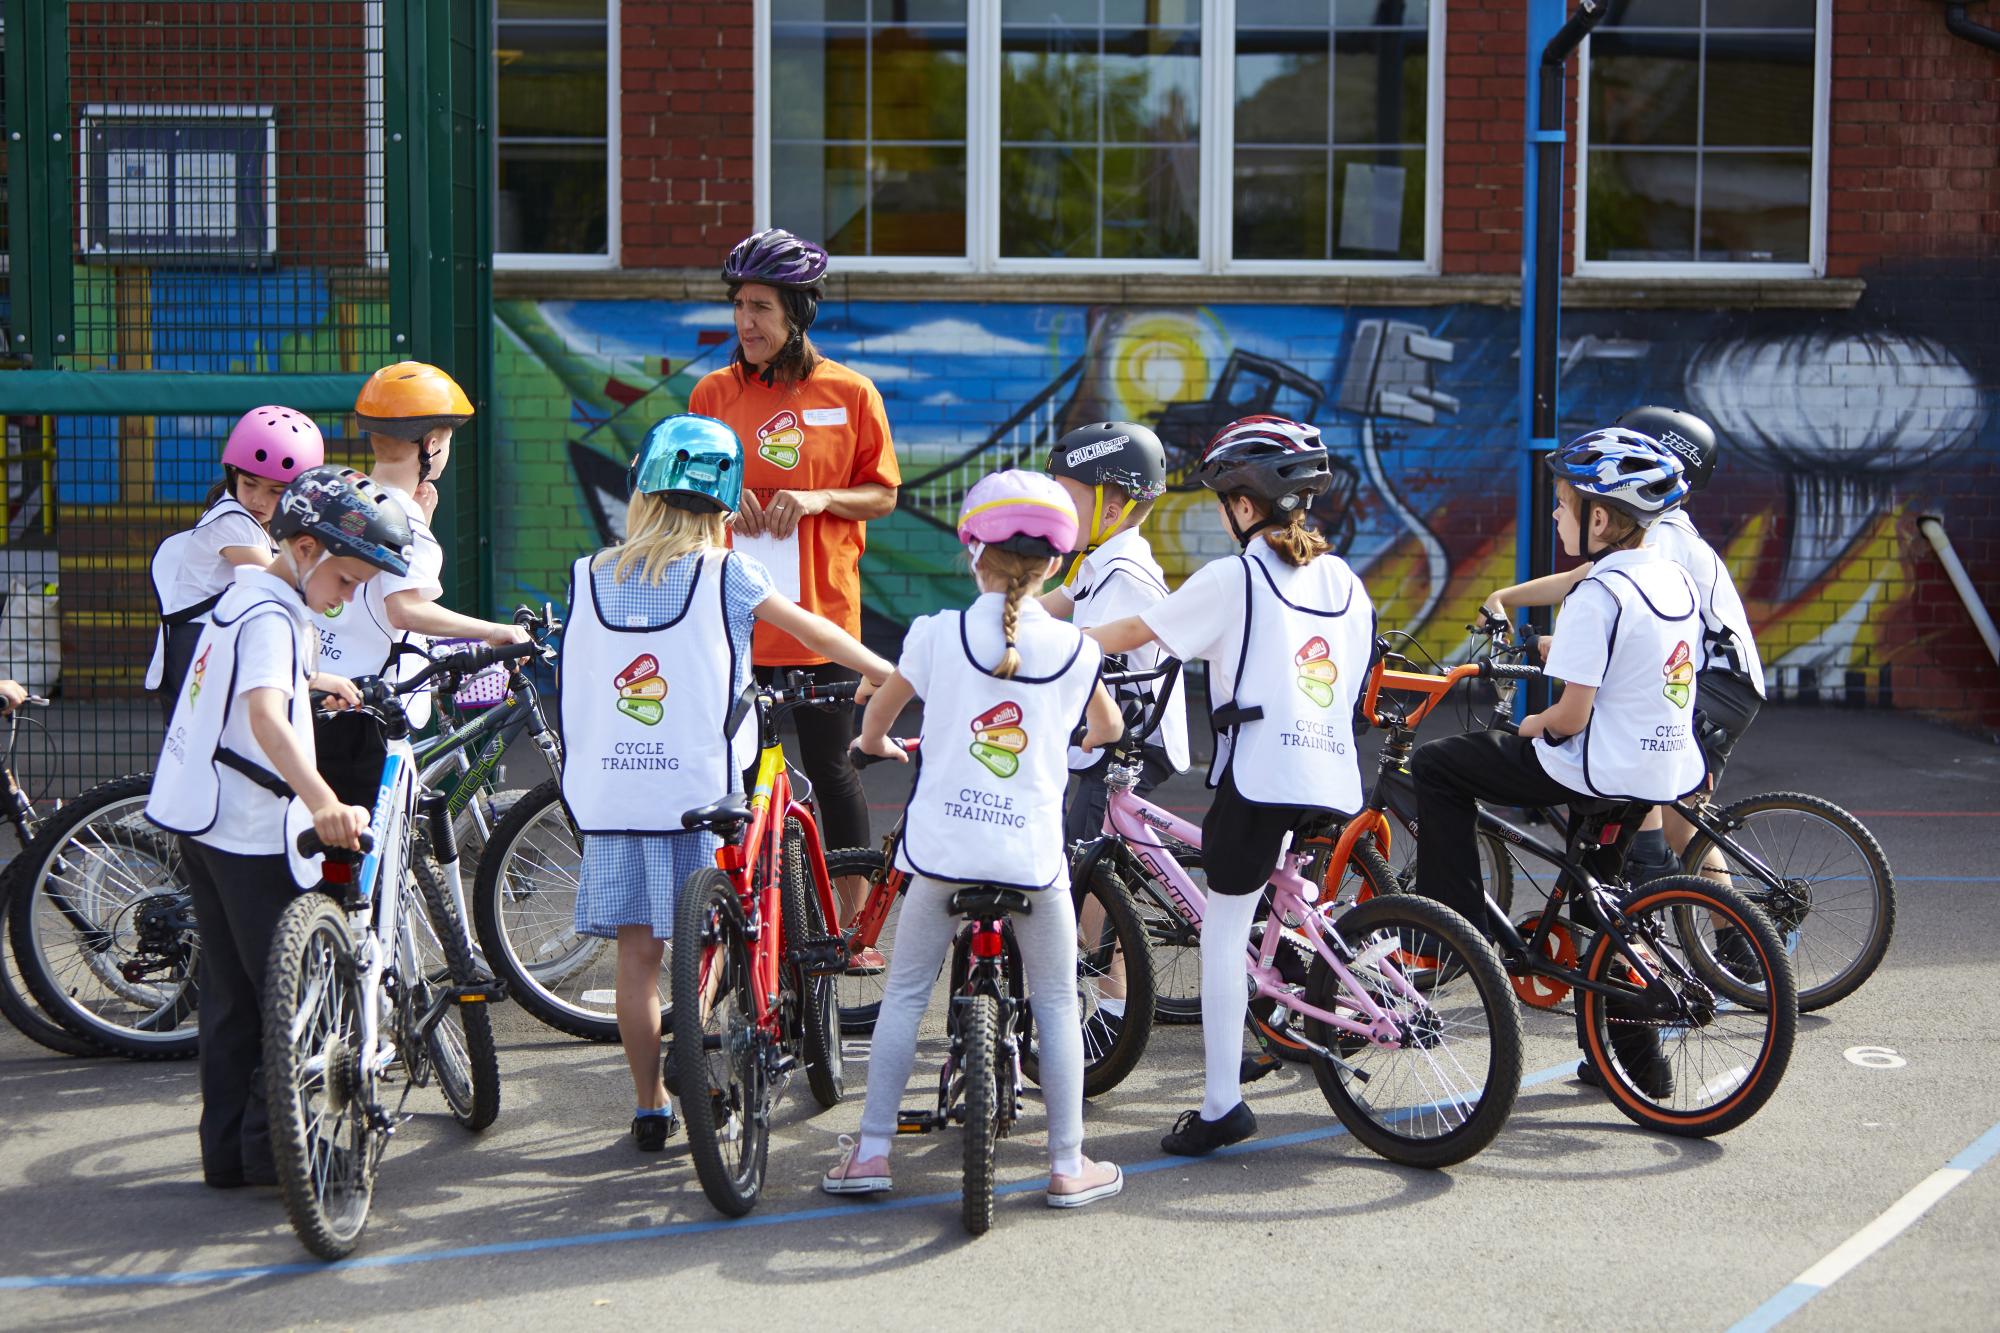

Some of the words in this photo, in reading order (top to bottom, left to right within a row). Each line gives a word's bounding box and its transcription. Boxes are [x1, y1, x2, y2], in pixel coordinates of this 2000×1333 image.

[1066, 441, 1106, 467] CRUCIAL
[1295, 720, 1334, 738] CYCLE
[1655, 725, 1686, 738] CYCLE
[614, 742, 664, 755] CYCLE
[1280, 733, 1345, 755] TRAINING
[601, 757, 679, 771] TRAINING
[960, 788, 1013, 811] CYCLE
[944, 802, 1026, 829] TRAINING
